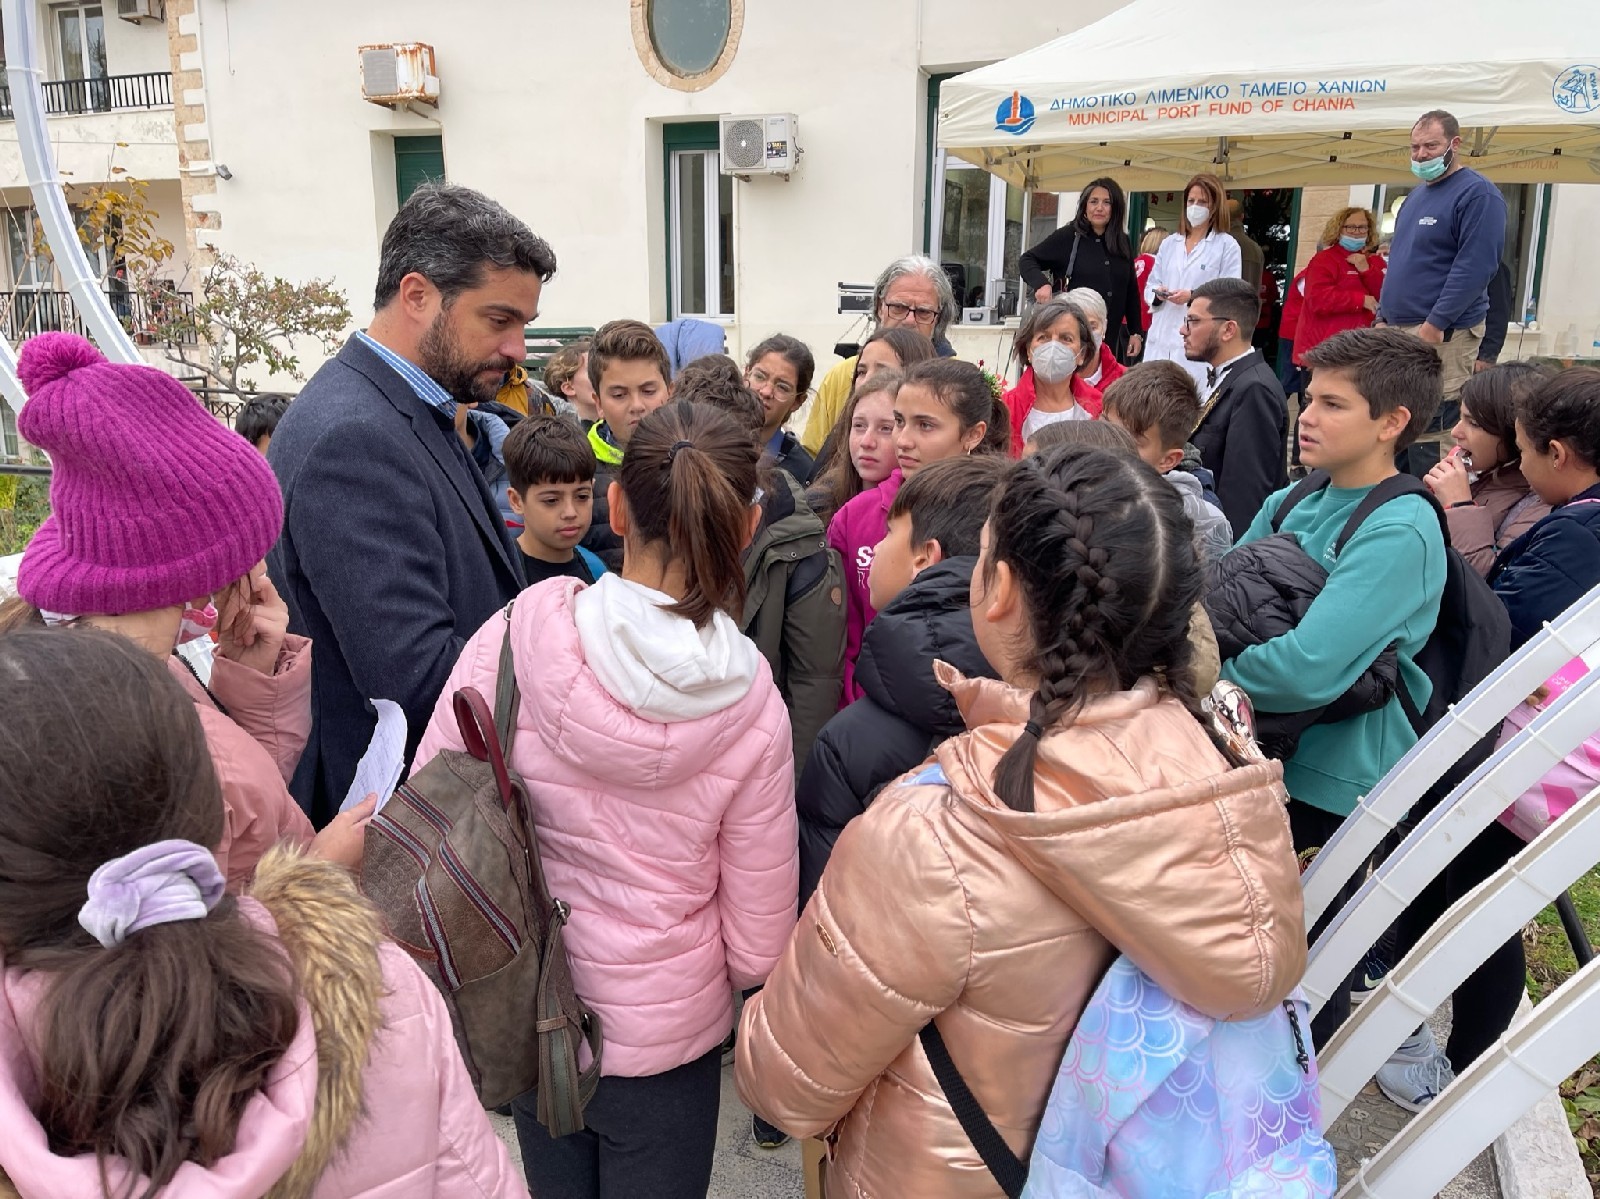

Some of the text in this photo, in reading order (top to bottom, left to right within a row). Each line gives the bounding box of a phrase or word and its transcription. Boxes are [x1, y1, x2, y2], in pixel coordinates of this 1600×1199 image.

[1050, 79, 1387, 111] ΔΗΜΟΤΙΚΟ ΛΙΜΕΝΙΚΟ ΤΑΜΕΙΟ ΧΑΝΙΩΝ
[1068, 97, 1355, 126] MUNICIPAL PORT FUND OF CHANIA
